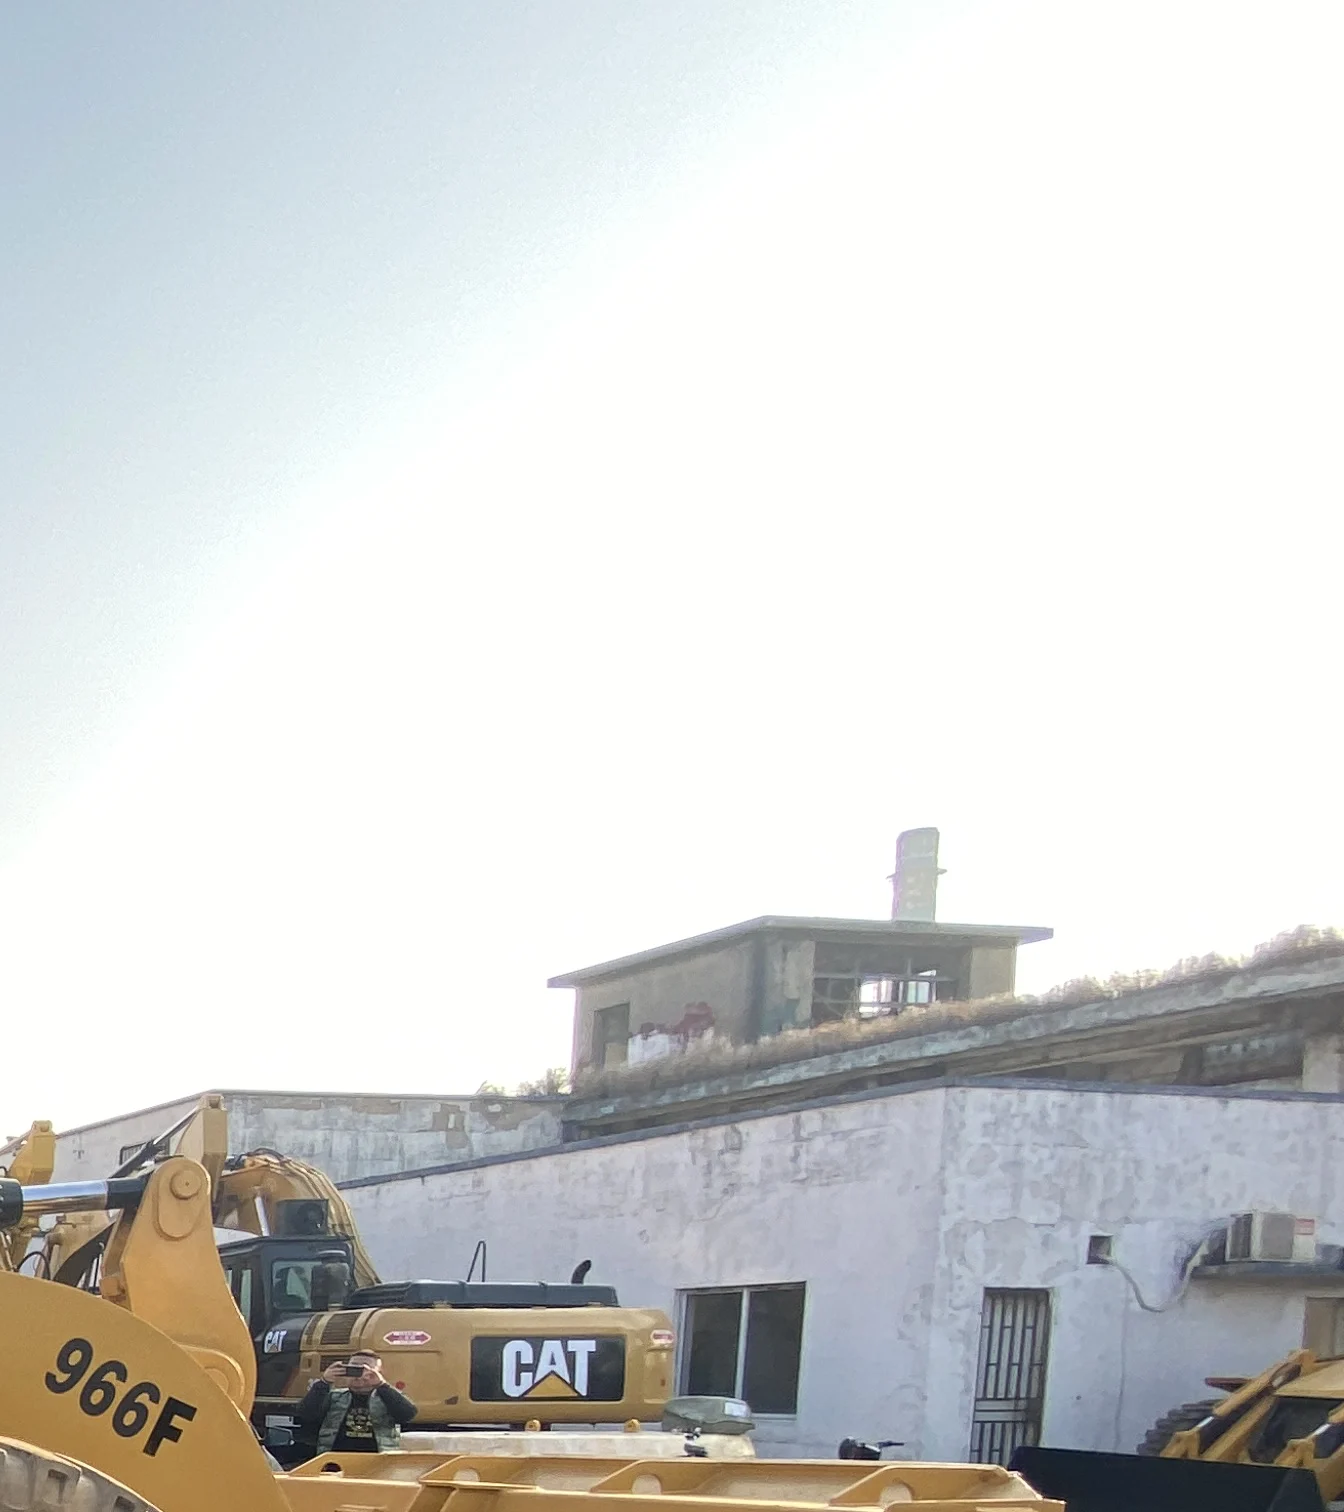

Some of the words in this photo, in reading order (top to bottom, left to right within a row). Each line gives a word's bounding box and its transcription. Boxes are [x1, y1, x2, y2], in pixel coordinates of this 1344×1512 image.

[264, 1330, 287, 1353] CAT
[502, 1339, 596, 1397] CAT
[45, 1338, 197, 1457] 966F
